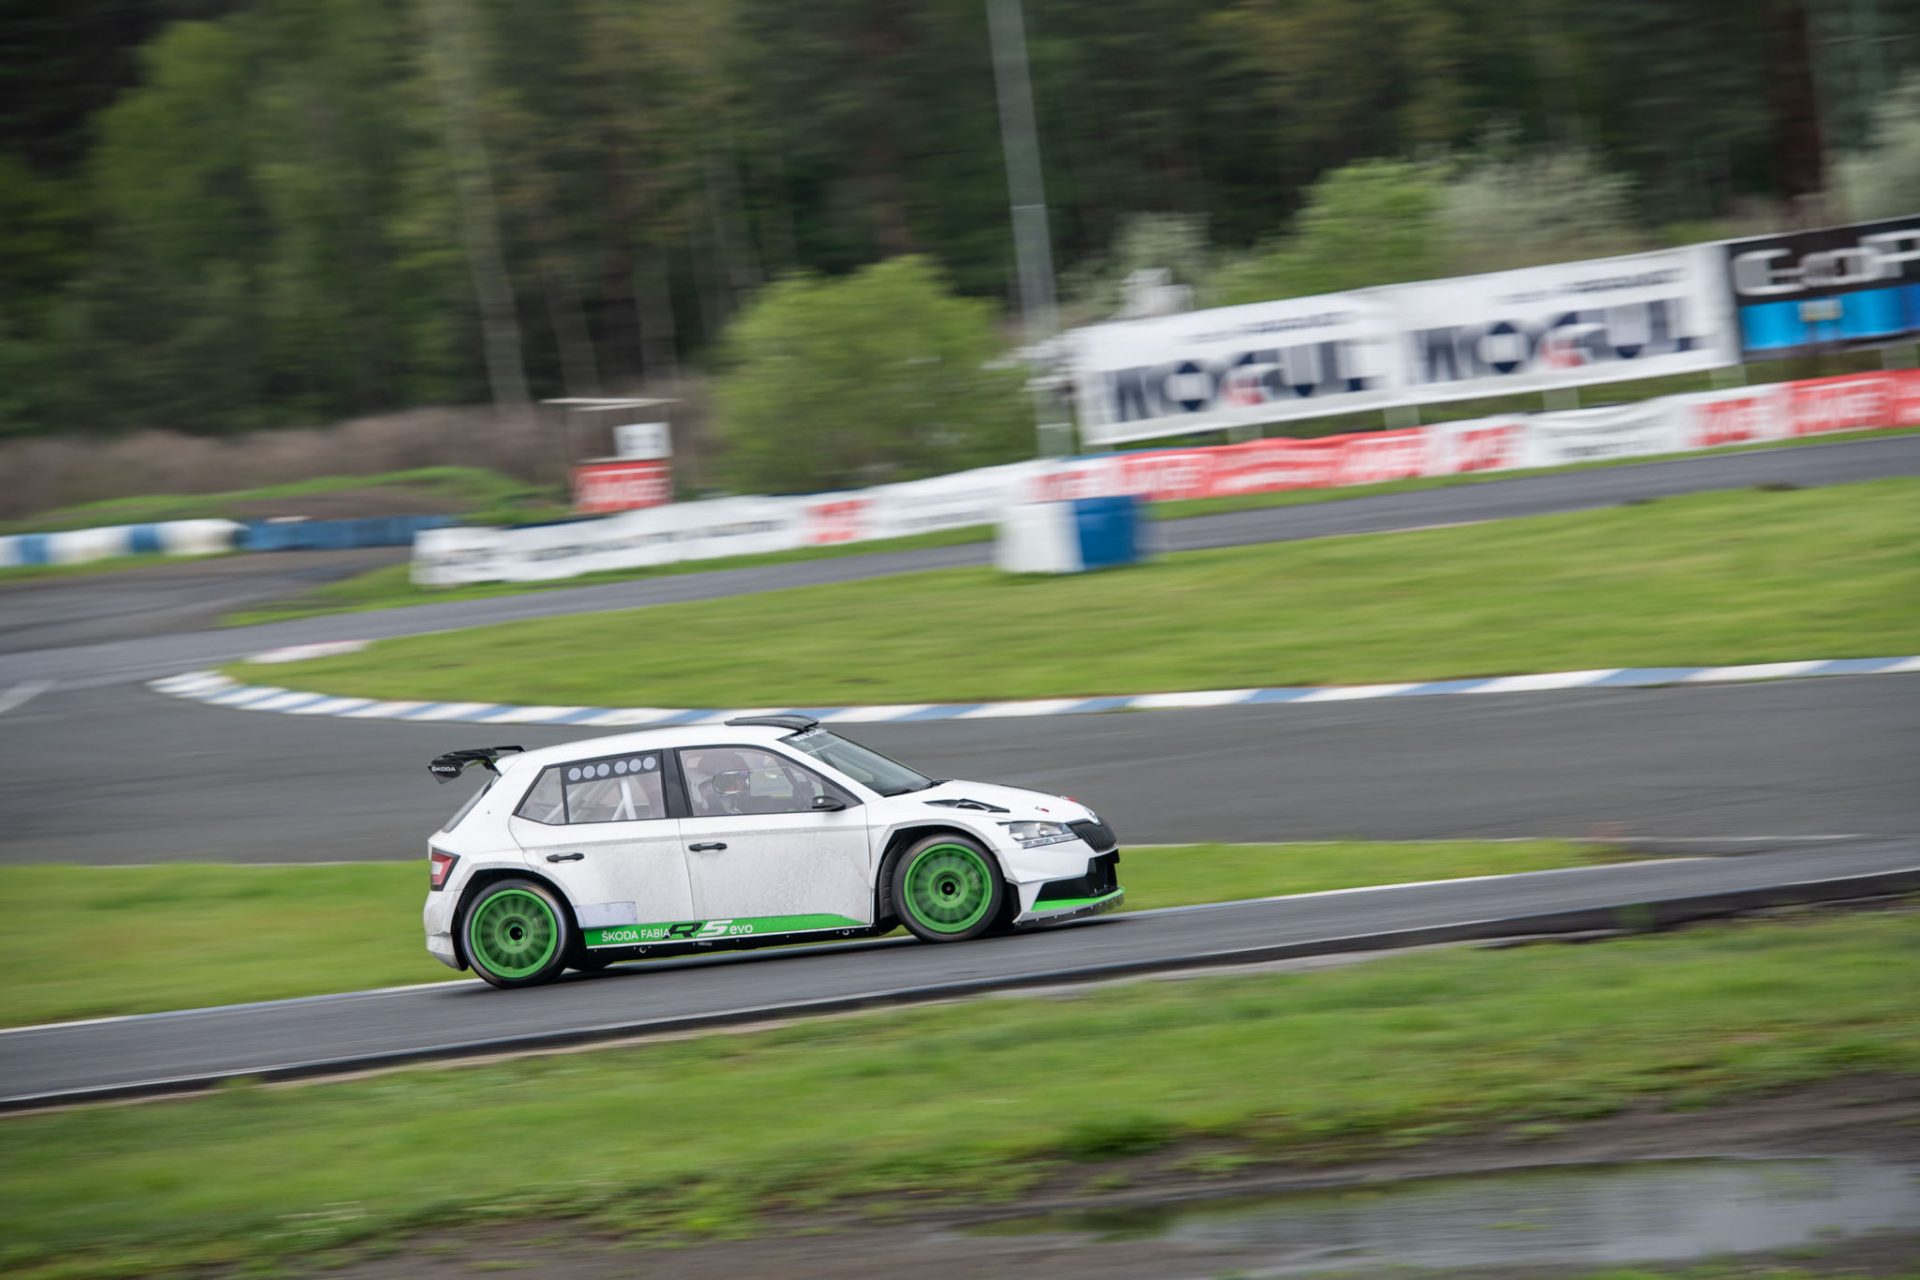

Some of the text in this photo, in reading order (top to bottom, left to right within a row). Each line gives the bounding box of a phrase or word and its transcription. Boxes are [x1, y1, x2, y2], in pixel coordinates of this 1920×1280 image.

[1106, 338, 1382, 423] MOGUL
[1408, 296, 1704, 383] MOGUL
[601, 928, 639, 943] ŠKODA
[640, 926, 671, 940] FABIA
[729, 923, 753, 935] evo
